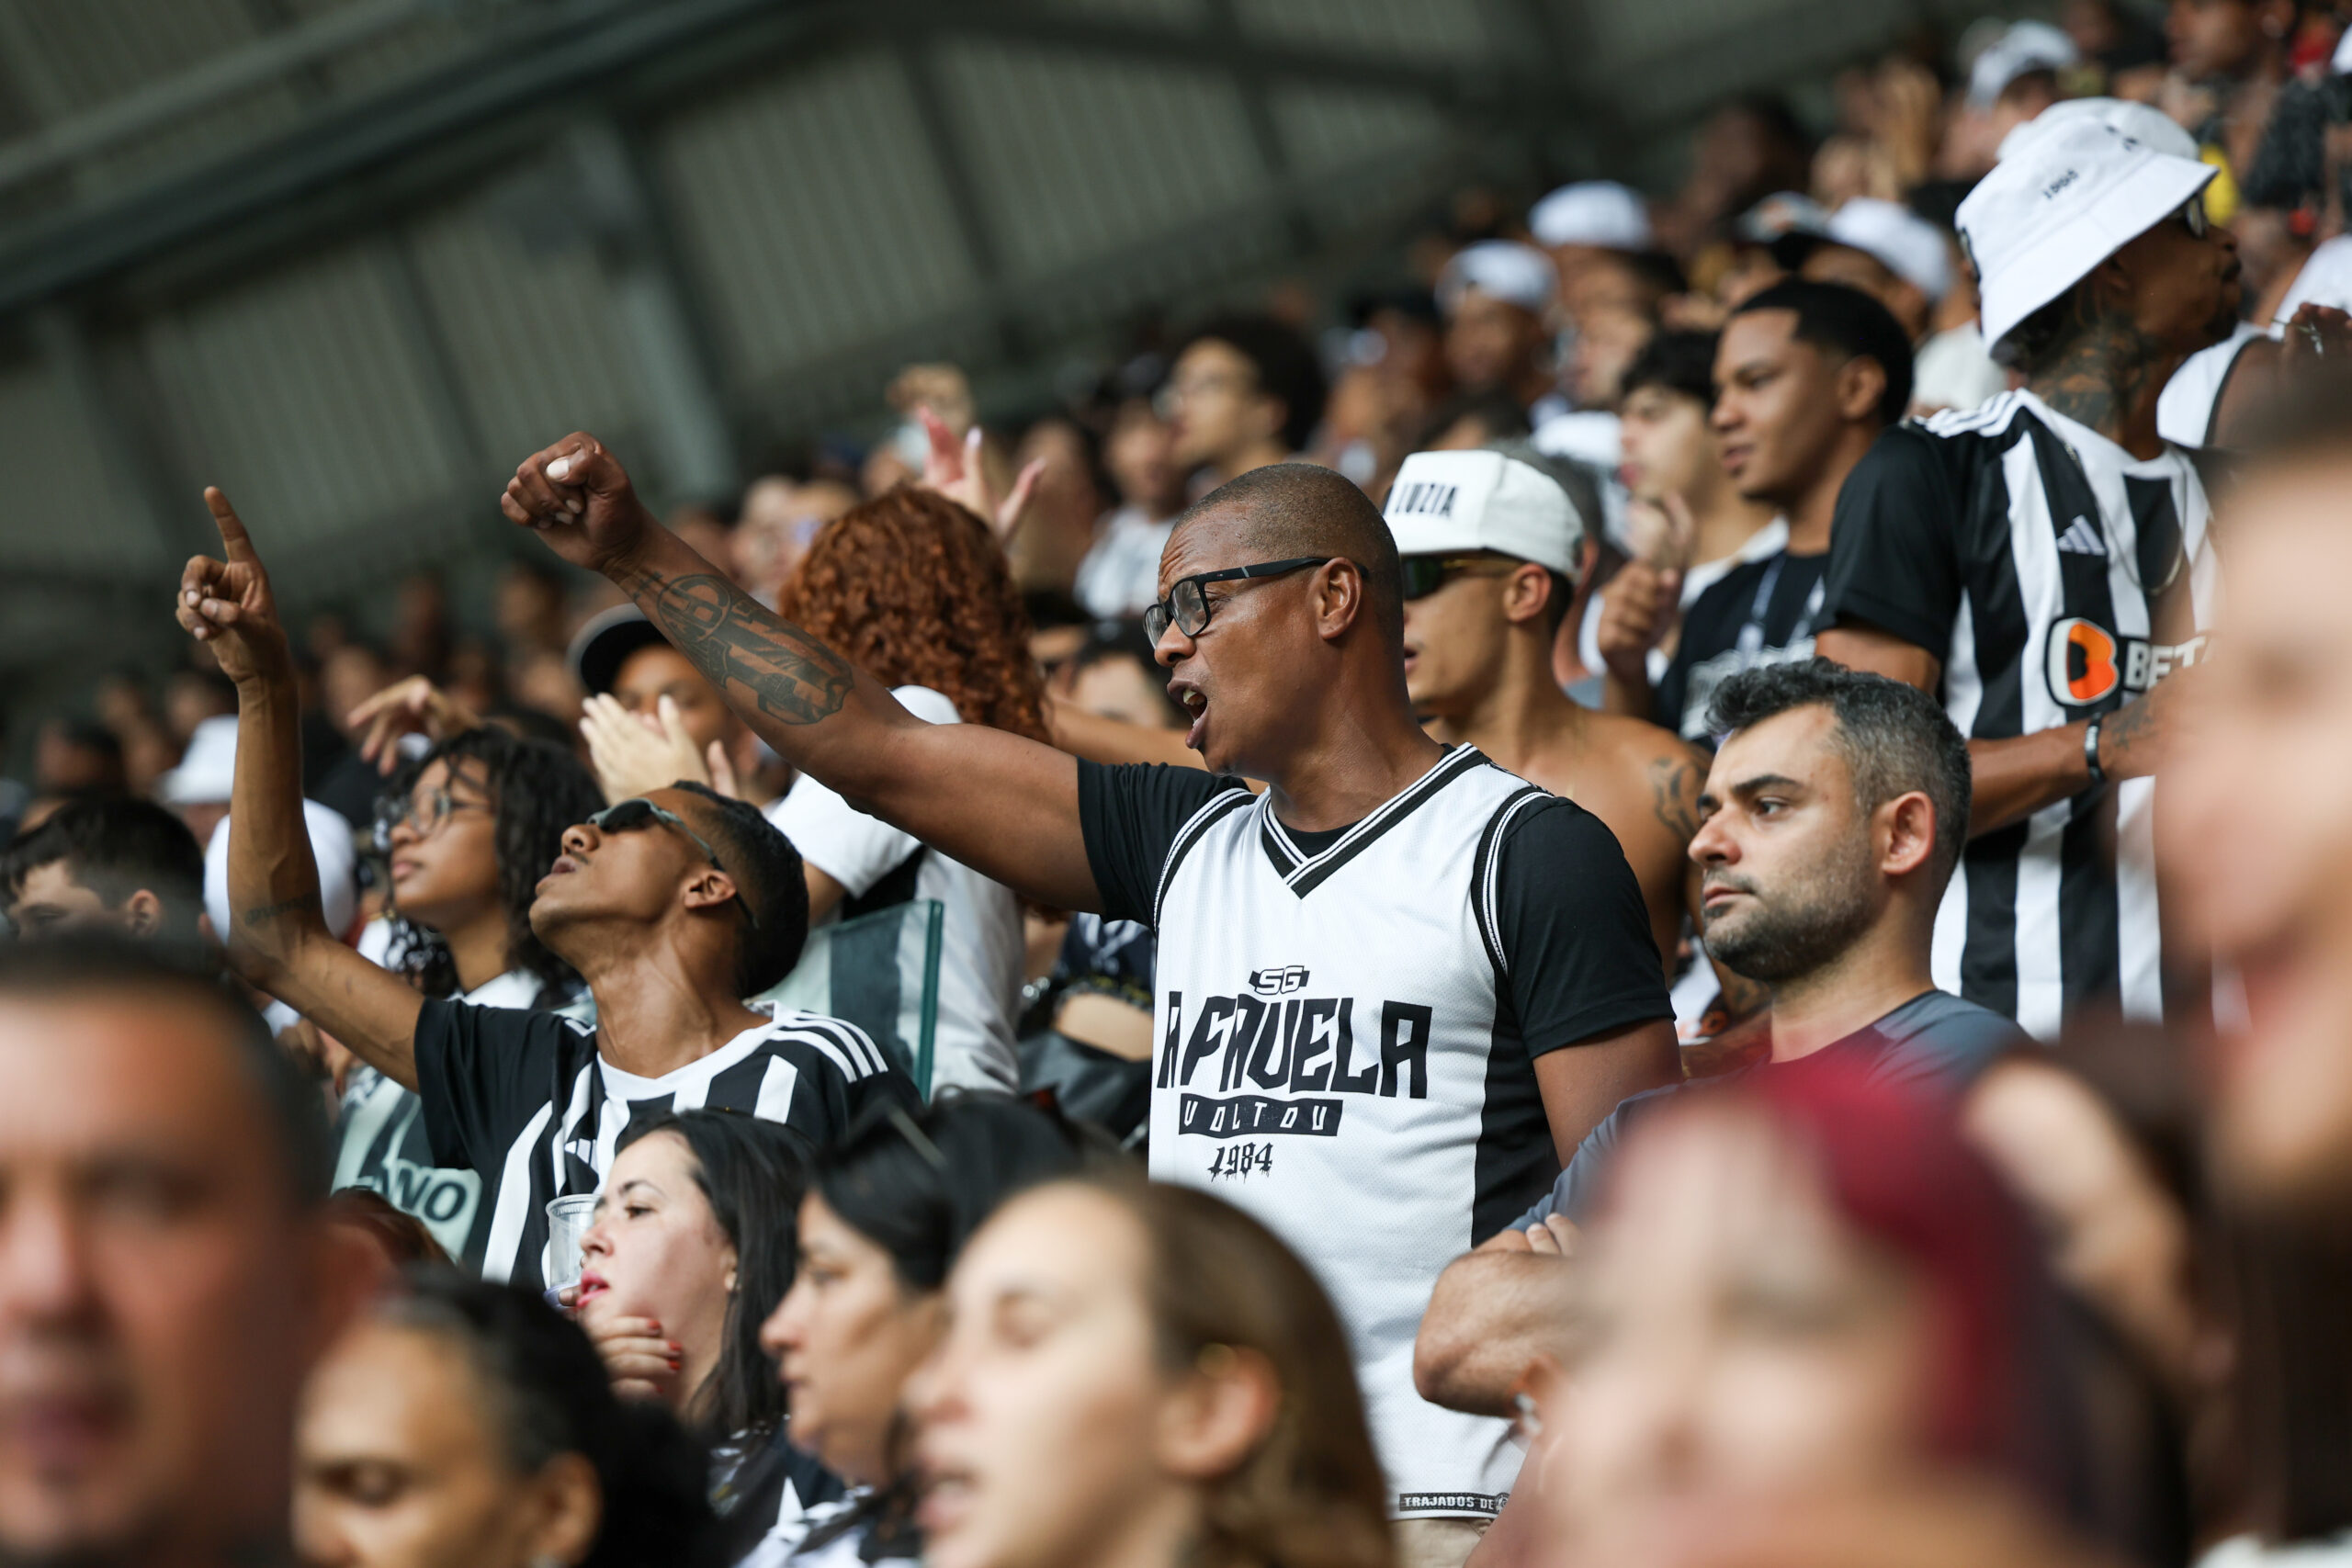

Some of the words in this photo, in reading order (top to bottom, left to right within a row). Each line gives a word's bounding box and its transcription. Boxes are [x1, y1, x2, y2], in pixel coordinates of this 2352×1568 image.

[2123, 636, 2213, 689] BET
[1254, 965, 1306, 995] SG
[1207, 1142, 1273, 1183] 1984
[1404, 1495, 1476, 1508] TRAJADOS
[1479, 1497, 1495, 1509] DE
